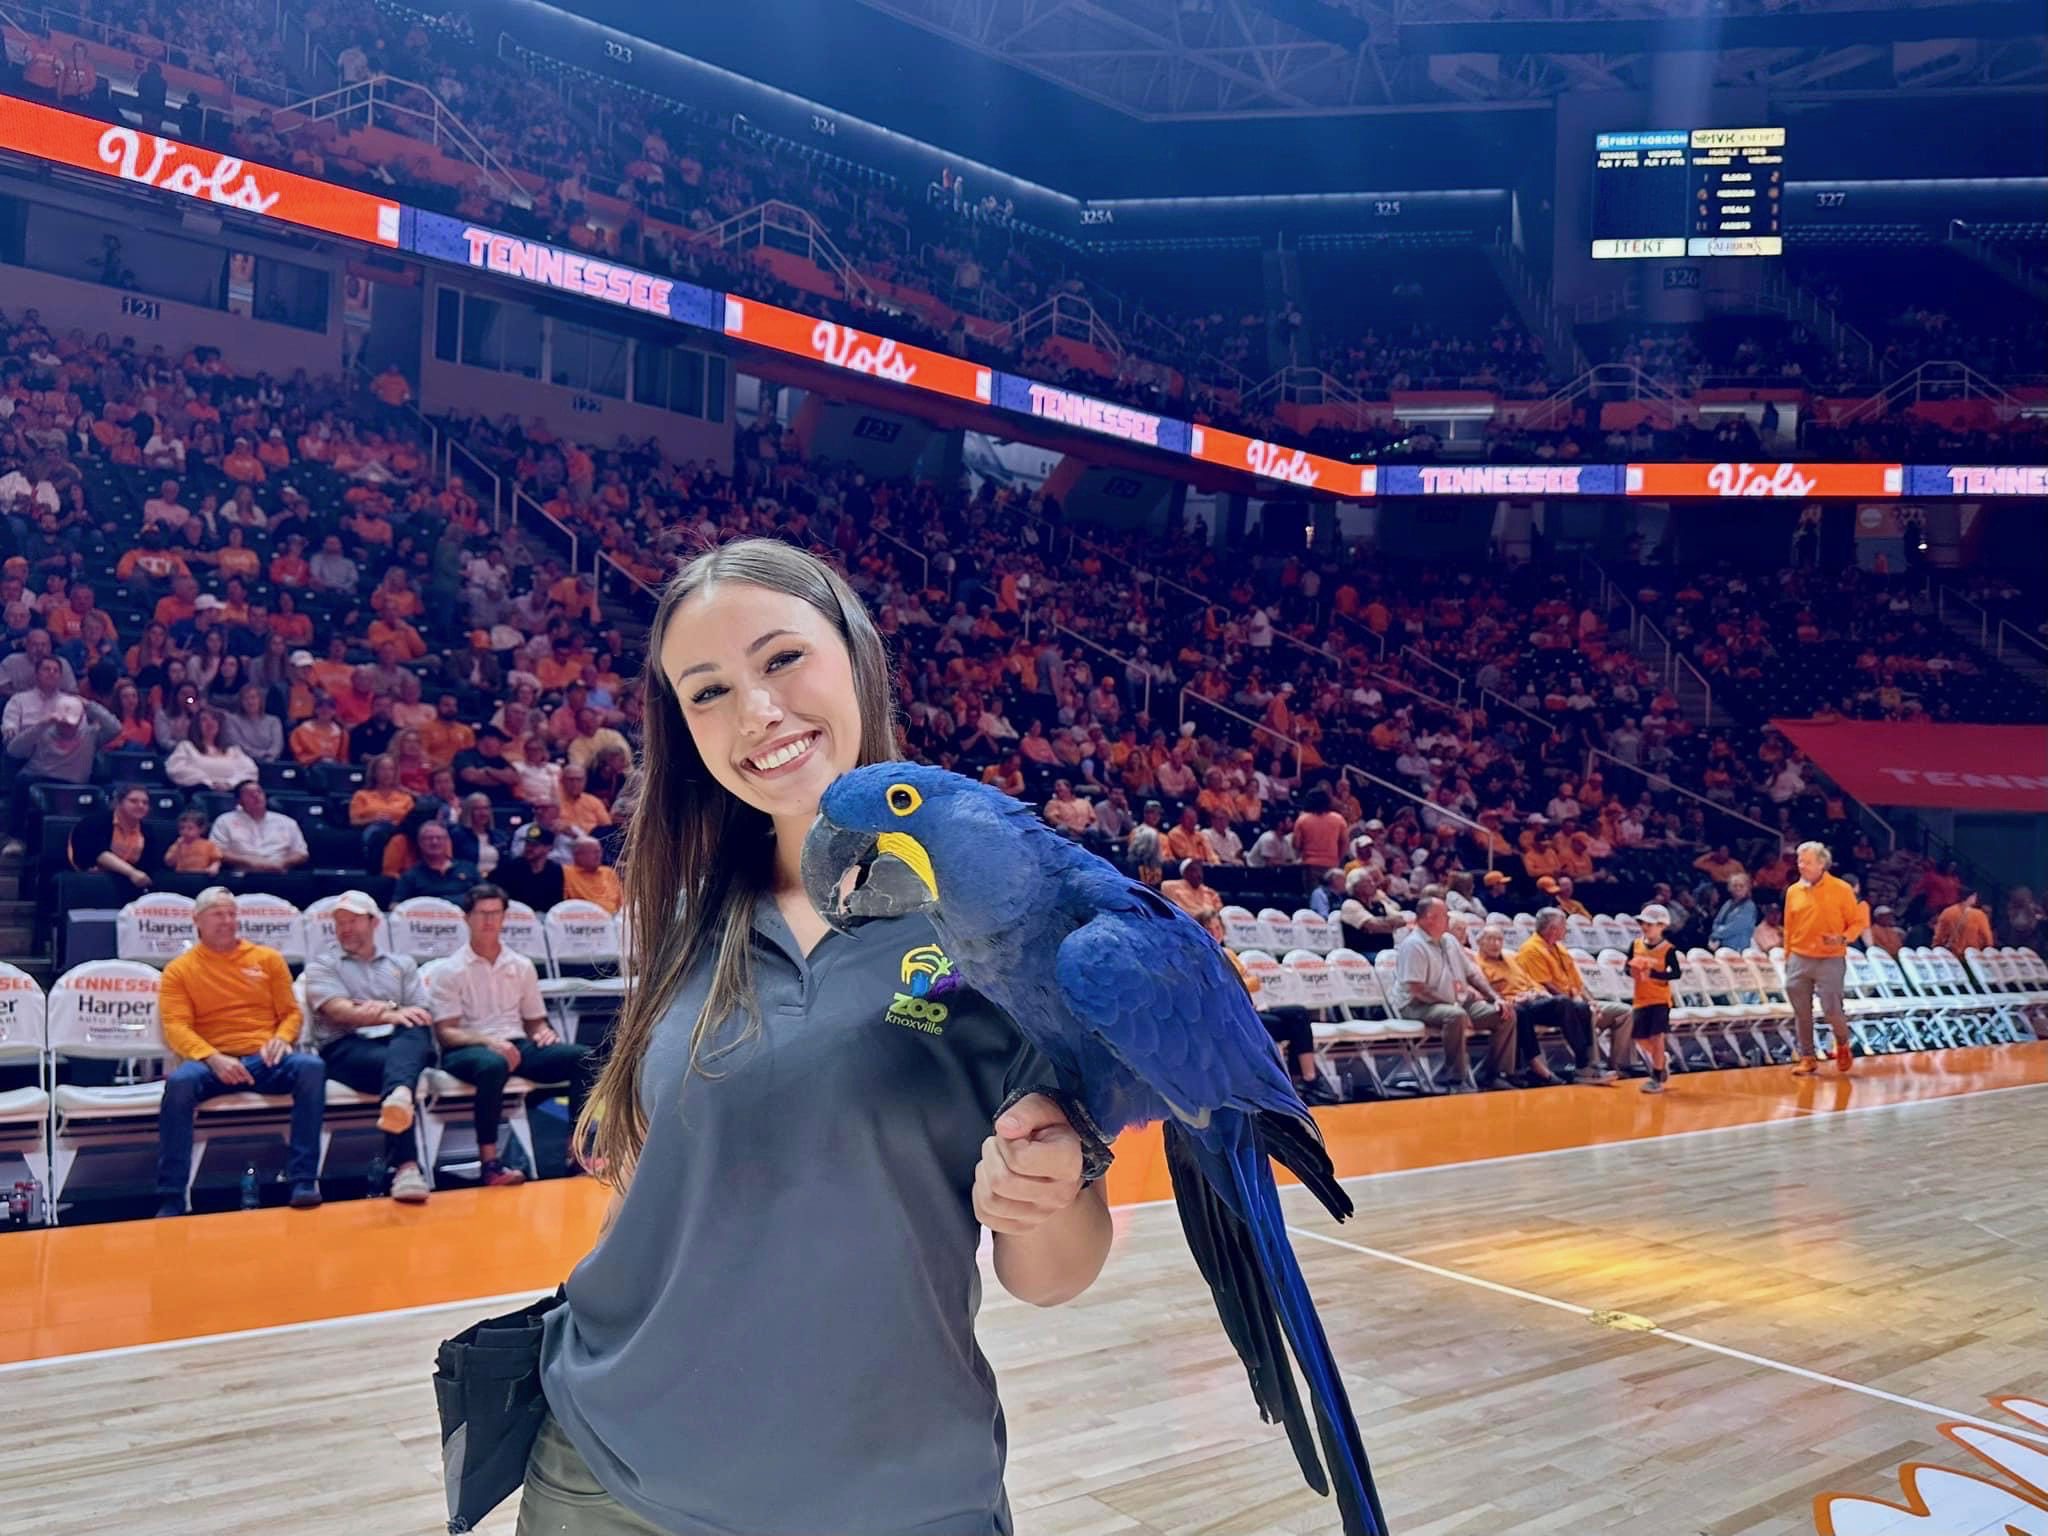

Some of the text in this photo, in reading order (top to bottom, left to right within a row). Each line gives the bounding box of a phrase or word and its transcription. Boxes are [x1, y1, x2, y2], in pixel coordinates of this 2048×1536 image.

[604, 40, 633, 63] 323
[811, 114, 836, 136] 324
[1609, 133, 1688, 146] FIRST HORIZON
[97, 125, 281, 214] Vols
[1374, 201, 1401, 216] 325
[1816, 192, 1846, 207] 327
[1080, 209, 1114, 225] 325A
[462, 226, 674, 317] TENNESSEE
[123, 297, 157, 320] 121
[811, 320, 918, 384] Vols
[1028, 383, 1161, 446] TENNESSEE
[1246, 439, 1320, 487] Vols
[1418, 466, 1583, 494] TENNESSEE
[1706, 464, 1816, 496] Vols
[1946, 466, 2048, 494] TENNE
[138, 919, 193, 936] Harper
[409, 921, 457, 936] Harper
[502, 924, 533, 936] rper
[78, 994, 156, 1018] Harper
[78, 1016, 107, 1024] AUTO
